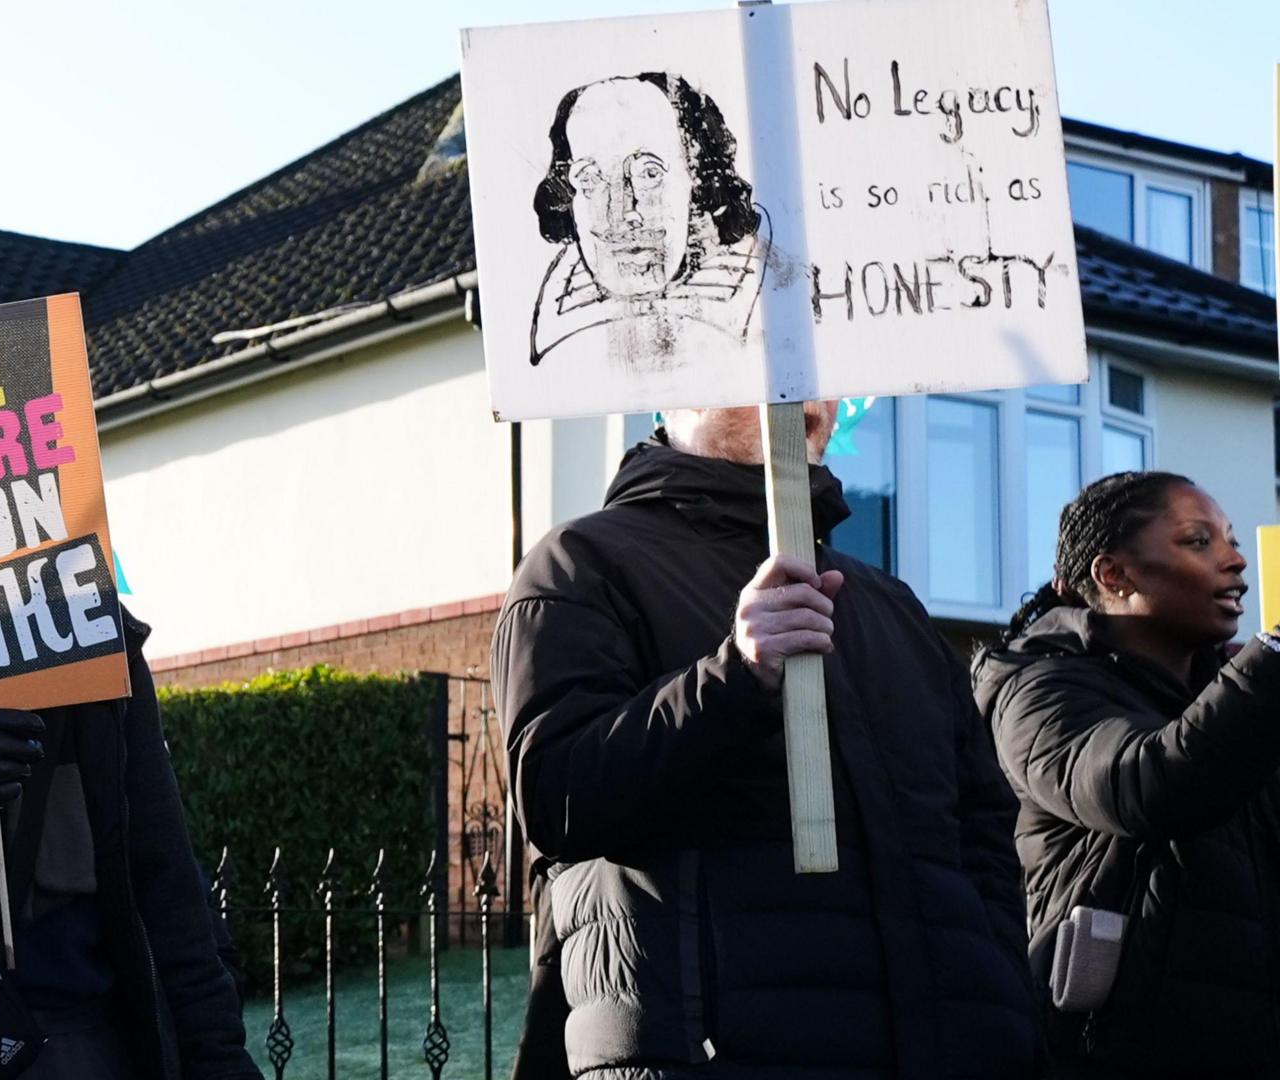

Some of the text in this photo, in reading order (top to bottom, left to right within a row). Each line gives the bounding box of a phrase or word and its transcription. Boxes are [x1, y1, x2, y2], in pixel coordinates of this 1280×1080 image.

[813, 57, 871, 124] No
[819, 182, 844, 210] is
[867, 185, 898, 208] so
[1008, 177, 1041, 200] as
[810, 246, 1055, 324] HONESTY
